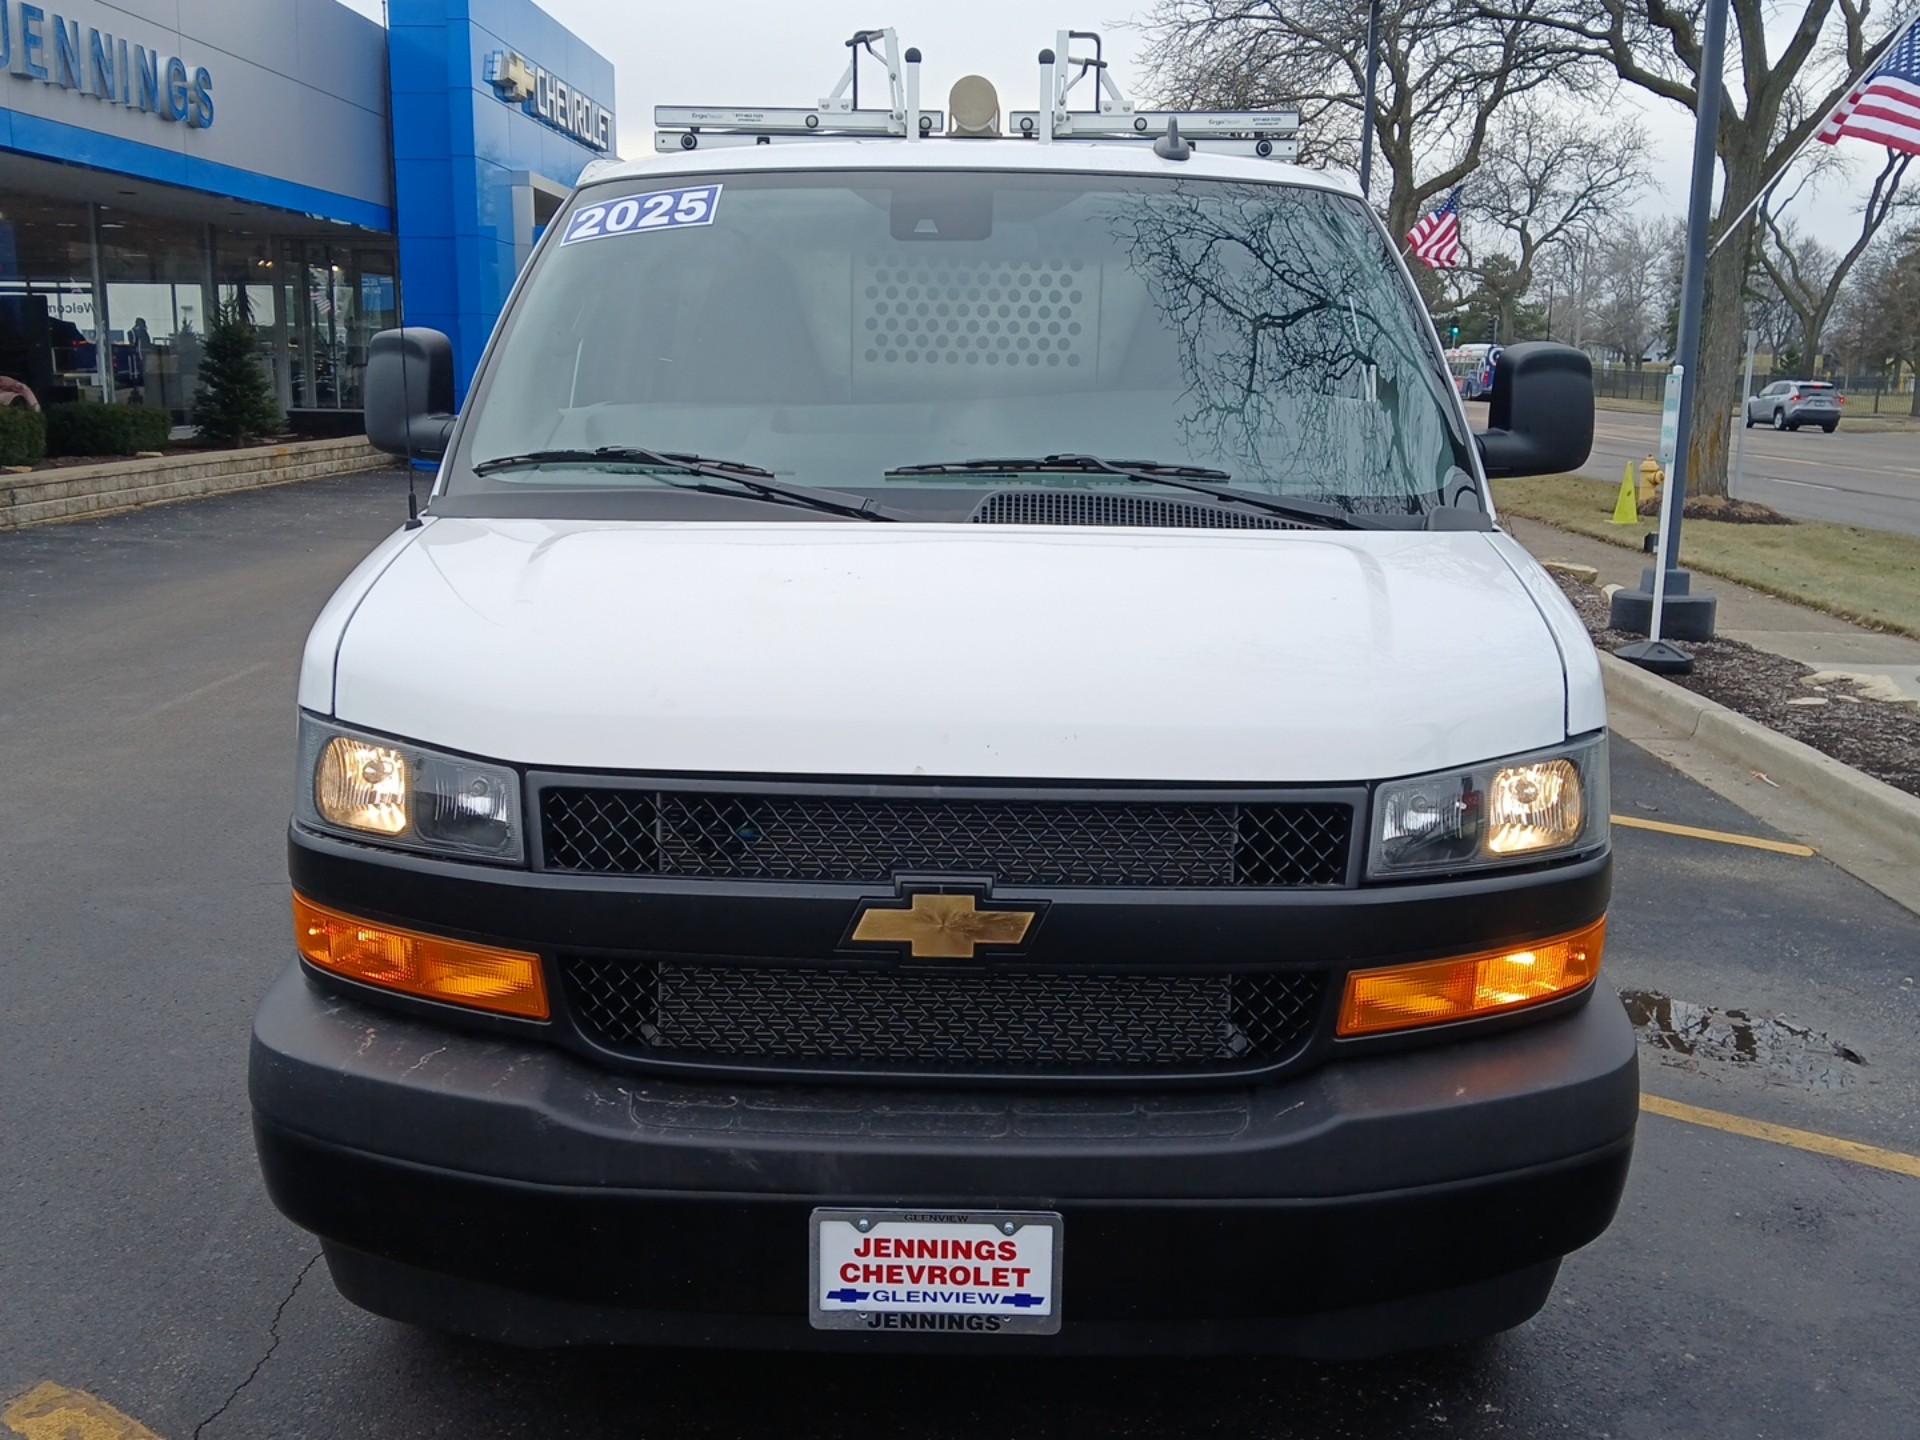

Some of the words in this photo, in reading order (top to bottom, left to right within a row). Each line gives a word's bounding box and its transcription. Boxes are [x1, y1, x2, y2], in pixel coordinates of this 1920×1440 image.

[0, 0, 214, 129] JENNINGS
[536, 66, 612, 151] CHEVROLET
[569, 190, 710, 241] 2025
[904, 1213, 969, 1224] GLENVIEW
[854, 1238, 1018, 1262] JENNINGS
[839, 1263, 1031, 1288] CHEVROLET
[872, 1290, 1000, 1305] GLENVIEW
[867, 1313, 1001, 1332] JENNINGS
